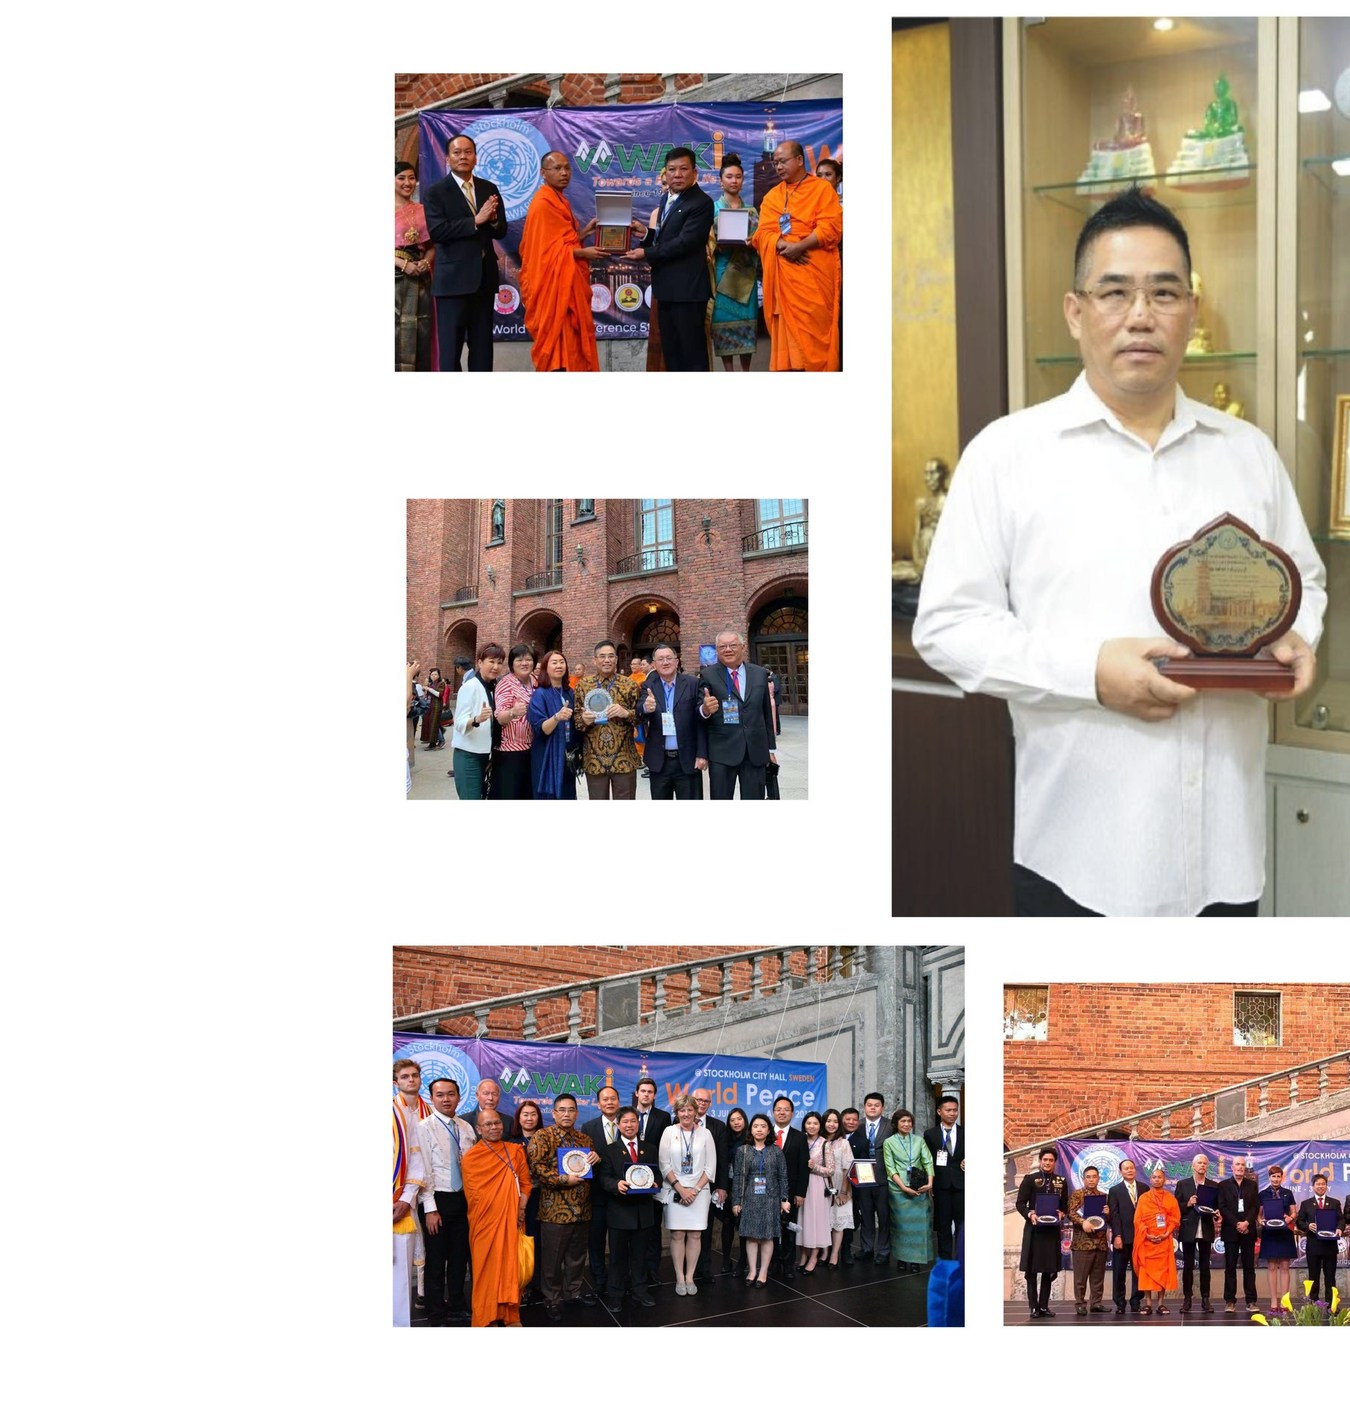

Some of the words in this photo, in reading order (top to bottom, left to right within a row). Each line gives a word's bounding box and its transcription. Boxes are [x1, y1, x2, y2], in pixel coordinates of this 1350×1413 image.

[472, 118, 530, 135] Stockholm
[592, 176, 642, 187] Towards
[506, 202, 533, 220] AWA
[492, 325, 526, 334] World
[406, 1043, 460, 1058] Stockholm
[532, 1067, 614, 1096] WAKi
[695, 1069, 702, 1077] @
[703, 1069, 750, 1079] STOCKHOLM
[752, 1071, 767, 1080] CITY
[769, 1073, 787, 1082] HALL,
[789, 1074, 815, 1083] SWEDEN
[665, 1082, 738, 1106] Wrld
[1301, 1152, 1347, 1160] STOCKHOLM
